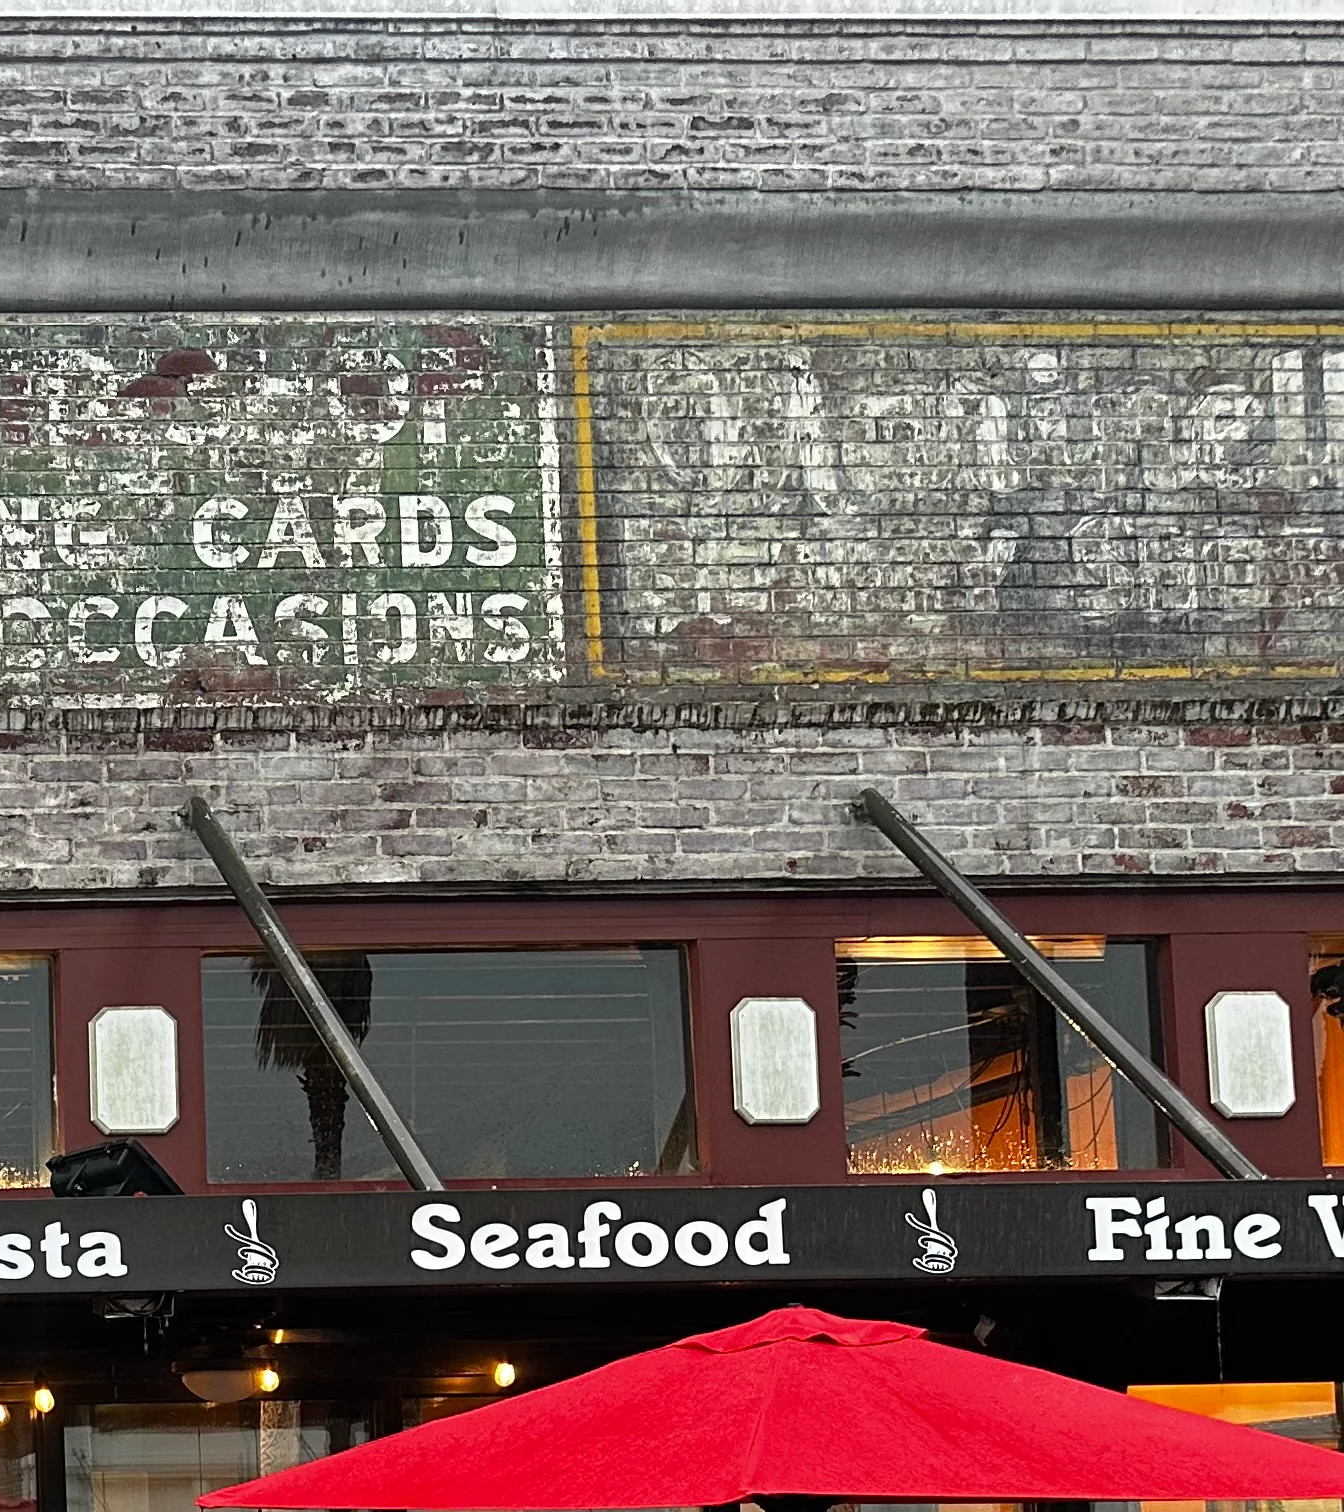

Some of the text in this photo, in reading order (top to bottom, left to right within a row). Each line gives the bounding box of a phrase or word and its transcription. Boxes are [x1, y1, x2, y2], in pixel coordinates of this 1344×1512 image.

[192, 494, 518, 572] CARDS
[409, 1198, 790, 1270] Seafood
[1085, 1196, 1283, 1263] Fine
